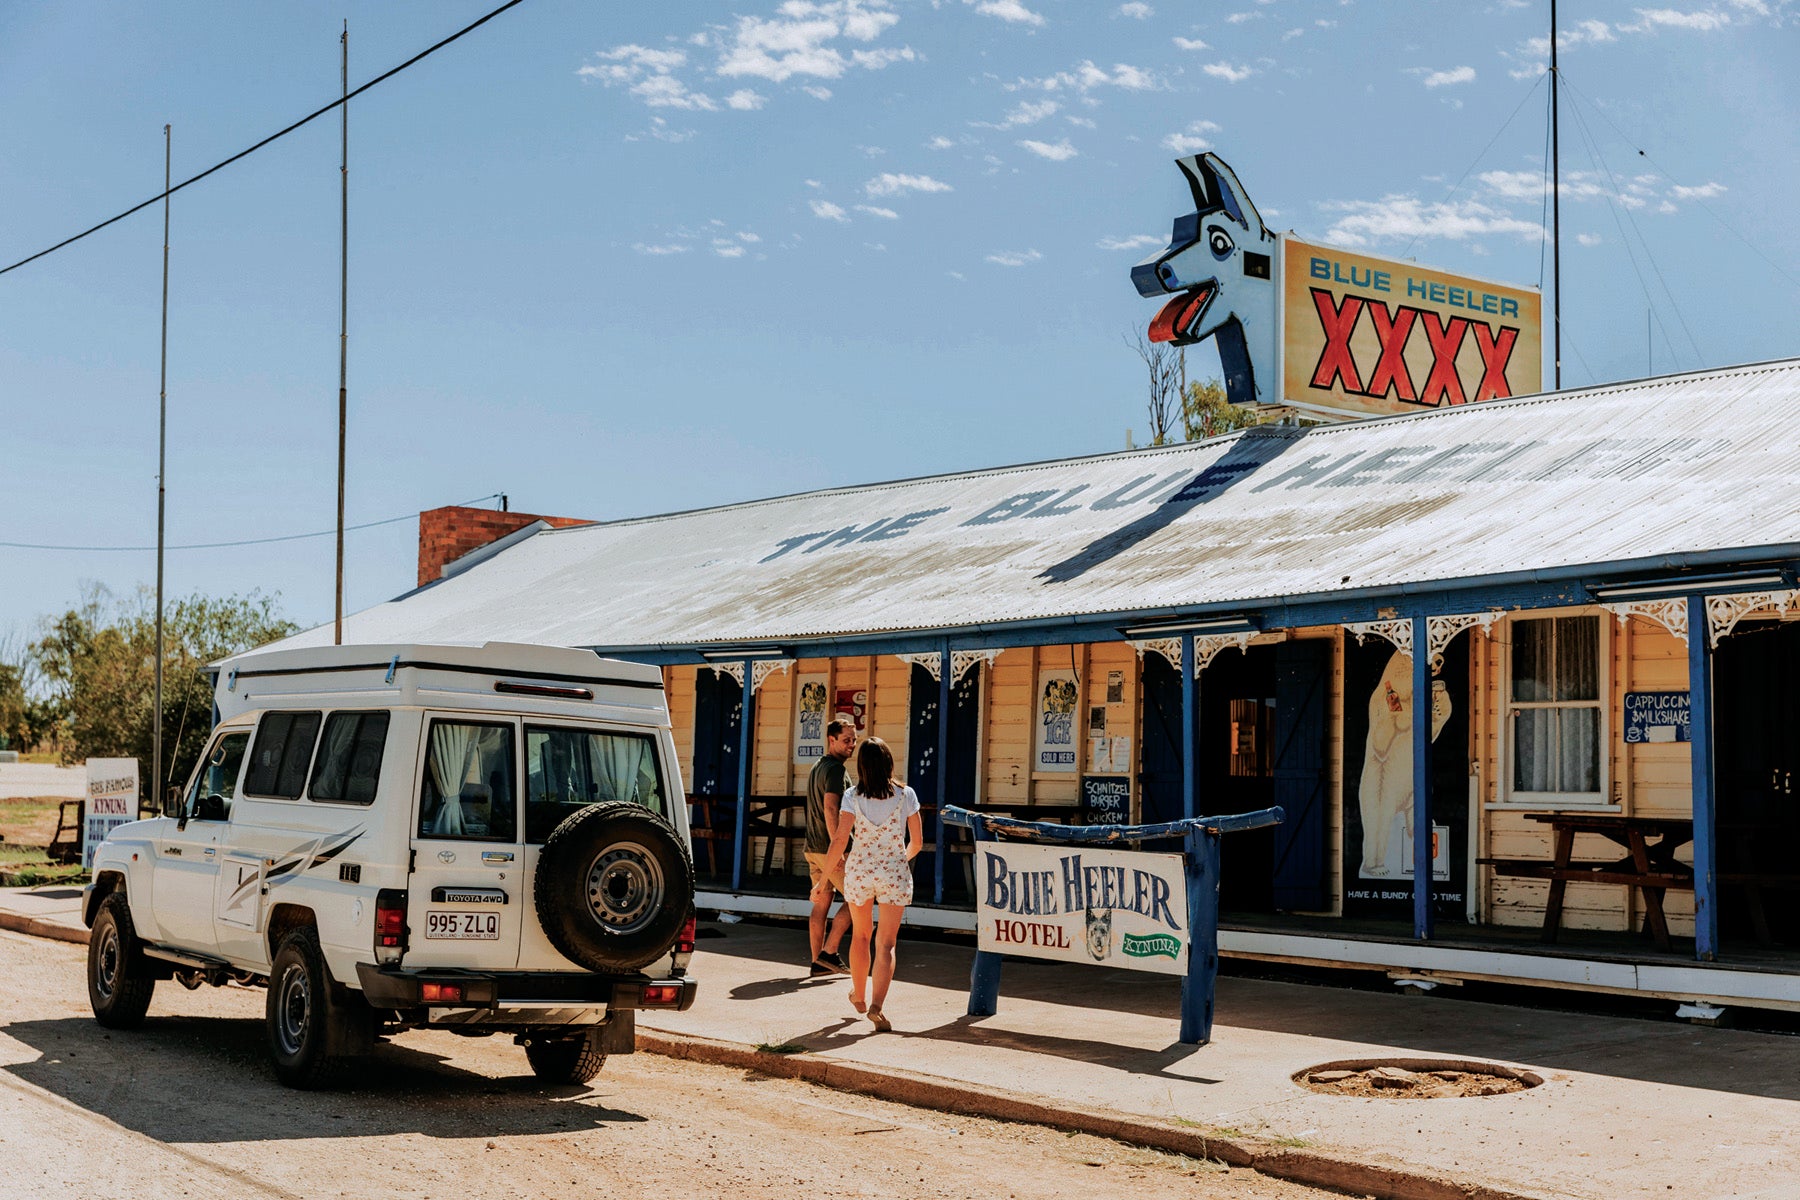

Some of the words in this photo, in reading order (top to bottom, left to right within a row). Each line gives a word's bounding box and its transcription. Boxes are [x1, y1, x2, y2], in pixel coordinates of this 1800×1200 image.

[1310, 257, 1392, 292] BLUE
[1407, 277, 1519, 318] HEELER
[1309, 286, 1520, 407] XXXX
[757, 506, 951, 564] THE
[957, 460, 1262, 527] BLUE
[1250, 438, 1733, 494] HEELER
[1625, 694, 1691, 710] CAPPUCCIN
[800, 719, 822, 739] ICE
[1044, 721, 1072, 745] ICE
[799, 746, 811, 756] SOLD
[811, 746, 824, 756] HERE
[1042, 752, 1057, 763] SOLD
[1058, 752, 1074, 763] HERE
[1085, 780, 1130, 796] SCHNITZEL
[94, 798, 127, 814] KYNUNA
[1090, 794, 1121, 811] BURGER
[1087, 811, 1123, 823] CHICKEN
[449, 894, 480, 903] TOYOTA
[482, 895, 503, 903] 4WD
[984, 851, 1058, 916] BLUE
[1059, 854, 1183, 931] HEELER
[1347, 890, 1370, 899] HAVE
[1372, 890, 1379, 899] A
[1381, 891, 1408, 899] BUNDY
[1441, 893, 1462, 902] TIME
[994, 919, 1071, 949] HOTEL
[1125, 936, 1177, 956] KYNUNA
